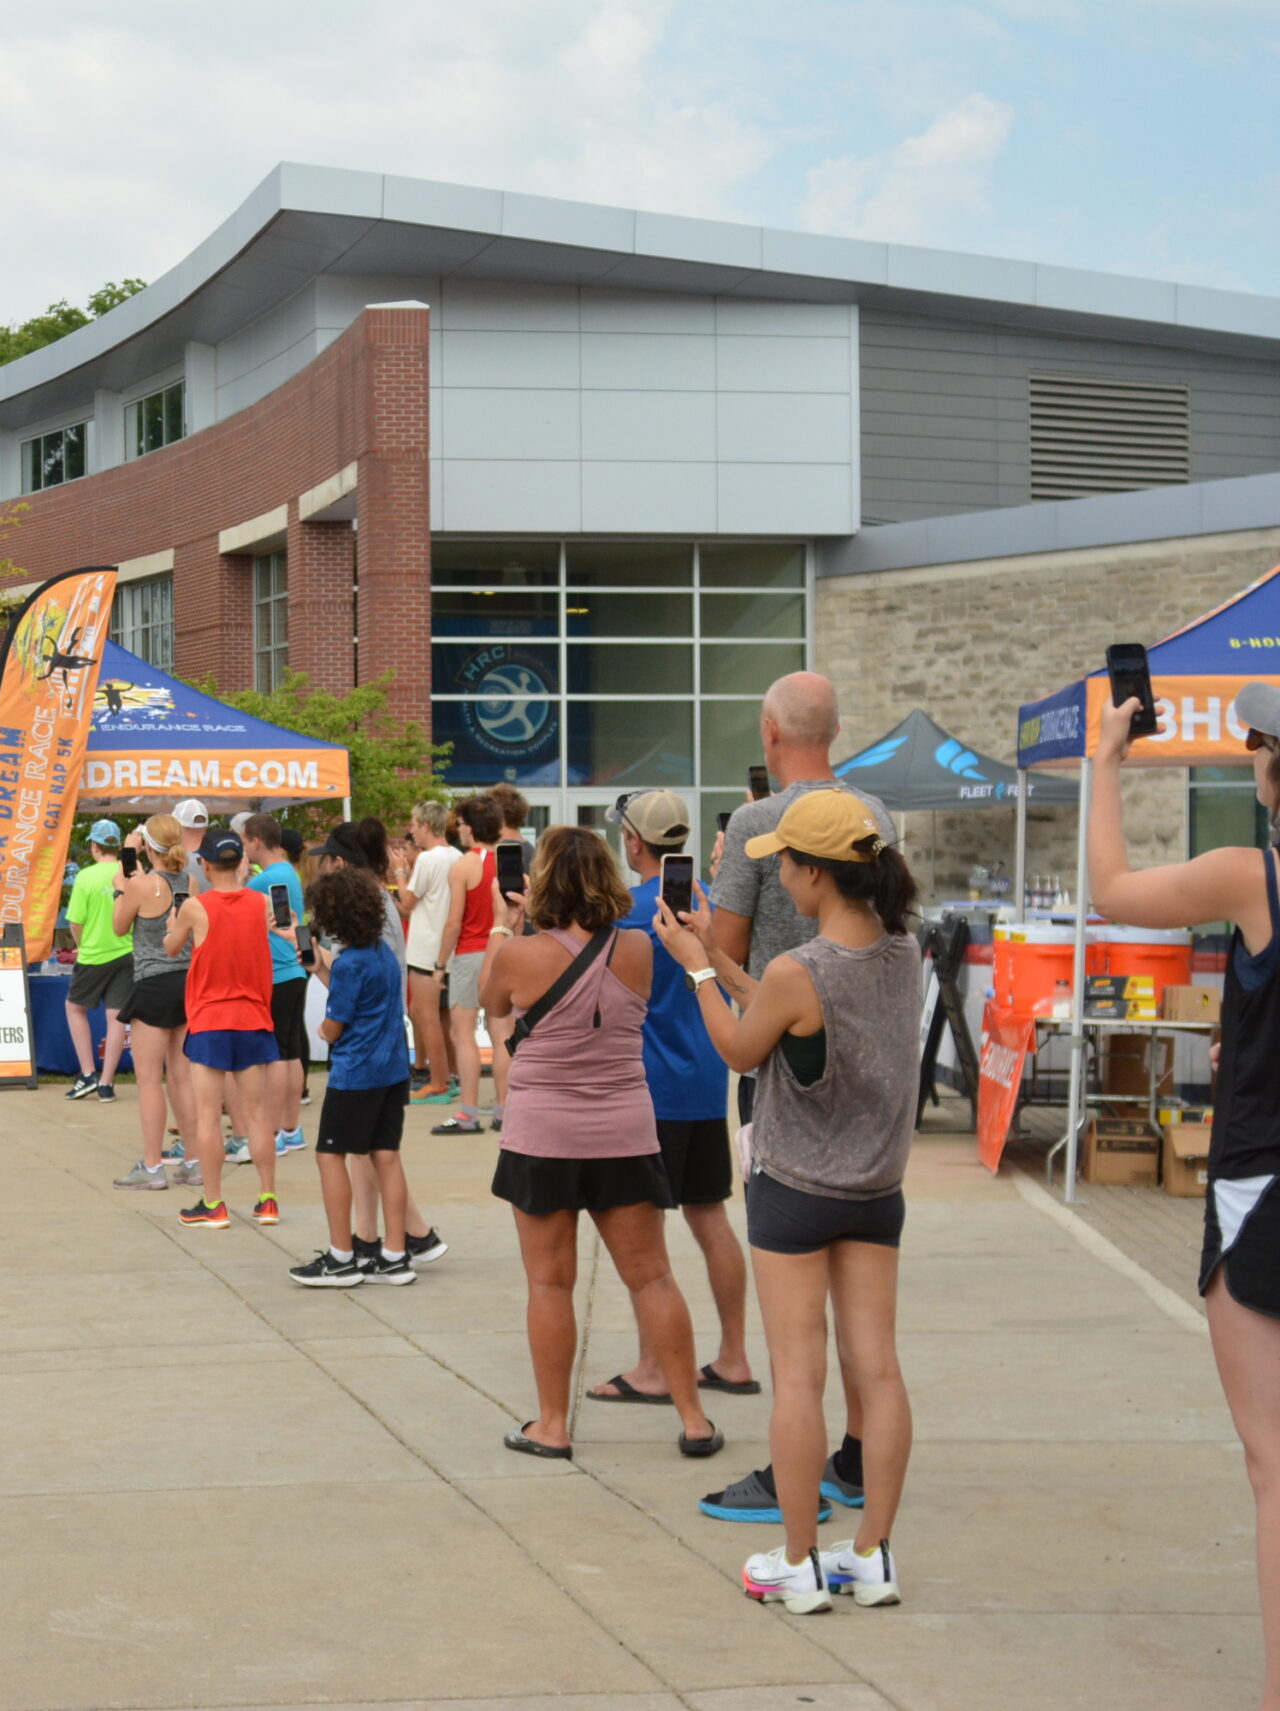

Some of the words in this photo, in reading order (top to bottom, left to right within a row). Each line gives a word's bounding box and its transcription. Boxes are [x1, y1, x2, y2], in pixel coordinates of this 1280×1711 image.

[464, 645, 506, 680] HRC
[24, 705, 57, 780] RACE
[101, 723, 202, 733] ENDURANCE
[203, 724, 247, 733] RACE
[57, 737, 74, 757] 5K
[49, 763, 67, 795] NAP
[960, 785, 994, 798] FLEET
[1007, 785, 1035, 797] FET
[44, 802, 62, 829] CAT
[27, 847, 55, 938] MARATHON
